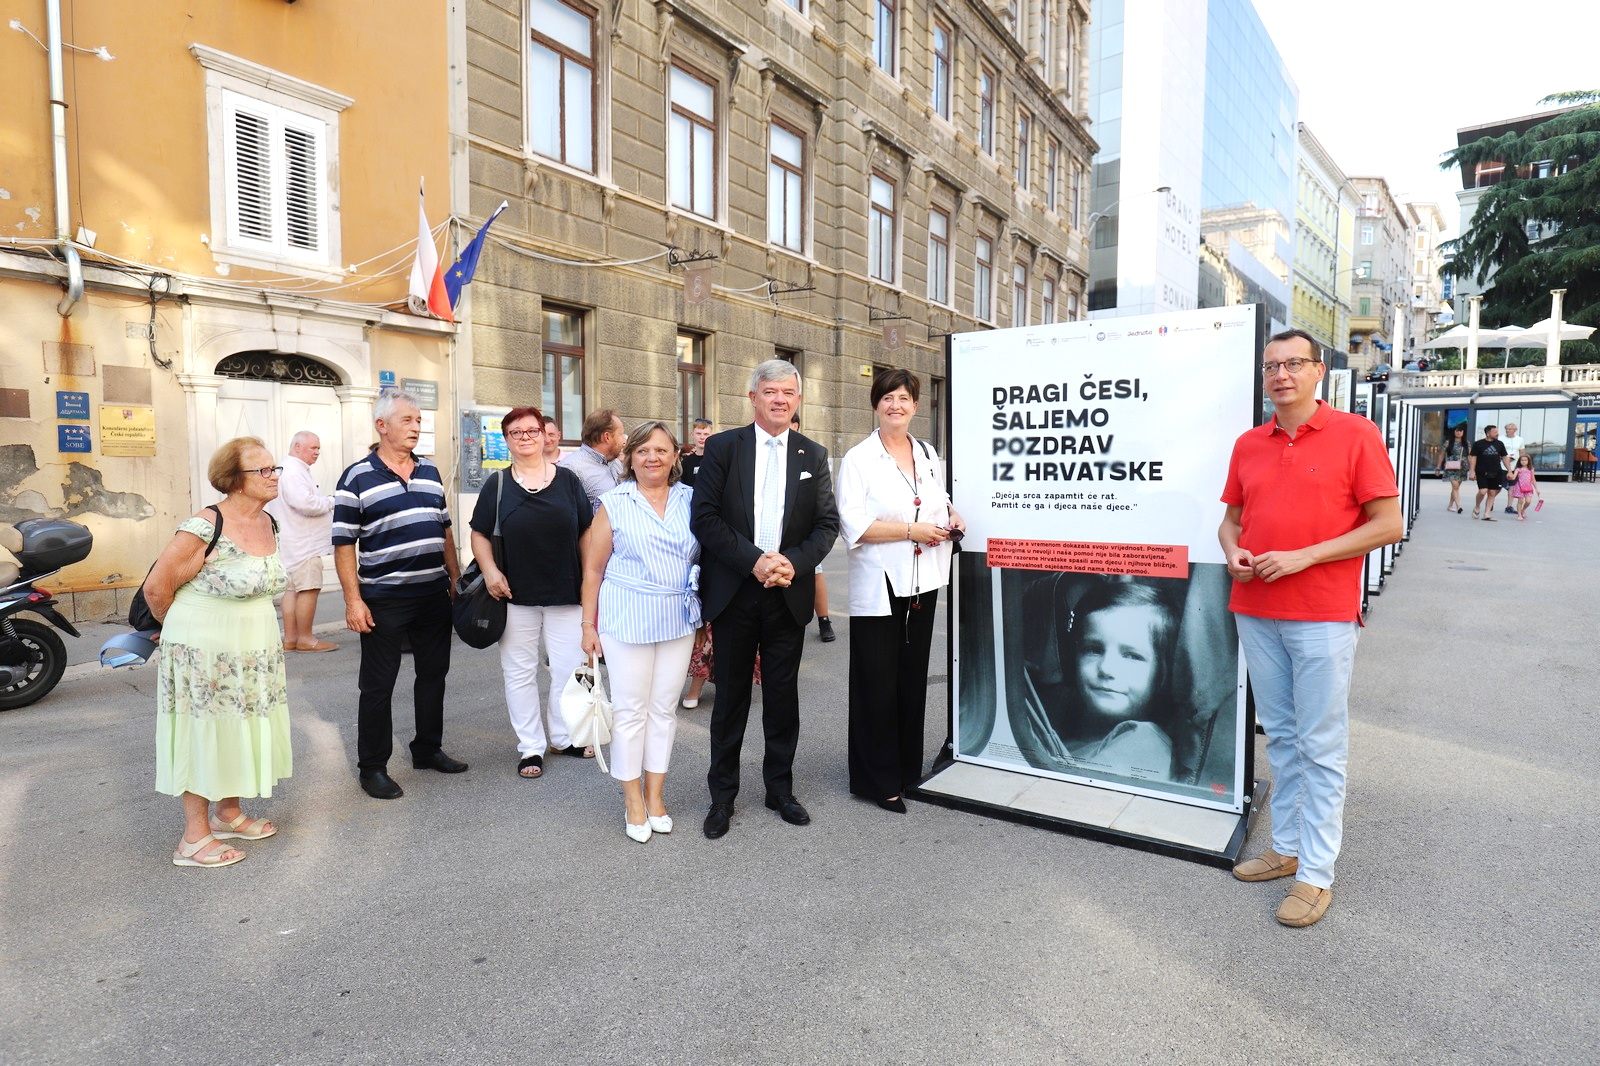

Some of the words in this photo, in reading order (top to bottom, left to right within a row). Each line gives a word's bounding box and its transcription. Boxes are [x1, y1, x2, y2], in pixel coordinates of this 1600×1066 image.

[1166, 189, 1193, 225] GRAND
[1165, 220, 1191, 255] HOTEL
[385, 372, 389, 380] 1
[993, 382, 1068, 405] DRAGI
[1079, 373, 1148, 401] ČESI,
[992, 405, 1109, 430] ŠALJEMO
[992, 434, 1114, 456] POZDRAV
[992, 462, 1014, 481] IZ
[1025, 461, 1163, 481] HRVATSKE
[991, 501, 1018, 509] Pamtit
[1054, 502, 1077, 511] djeca
[1080, 502, 1102, 510] naše
[1044, 492, 1084, 500] zapamtit
[1122, 552, 1167, 560] zaboravljena.
